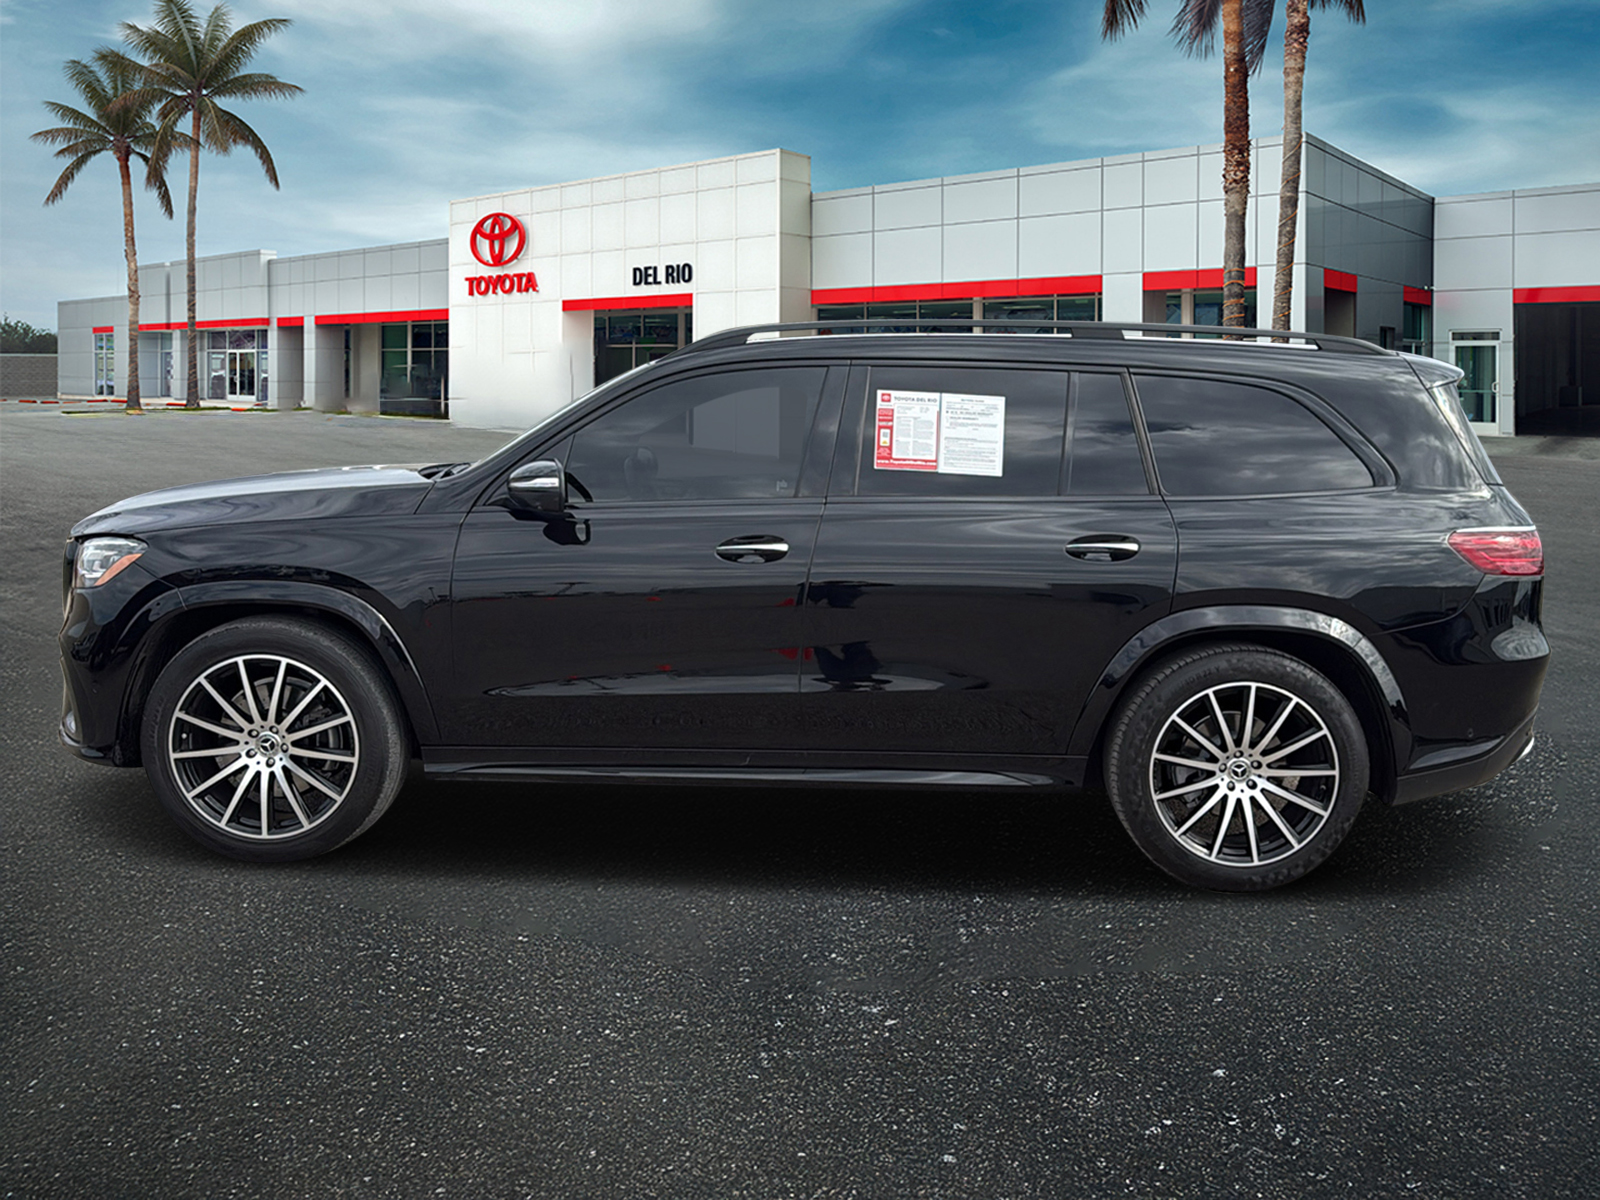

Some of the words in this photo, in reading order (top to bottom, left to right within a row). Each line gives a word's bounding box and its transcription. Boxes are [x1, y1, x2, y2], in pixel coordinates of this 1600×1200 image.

[465, 272, 538, 297] TOYOTA
[632, 266, 662, 286] DEL
[665, 263, 693, 284] RIO
